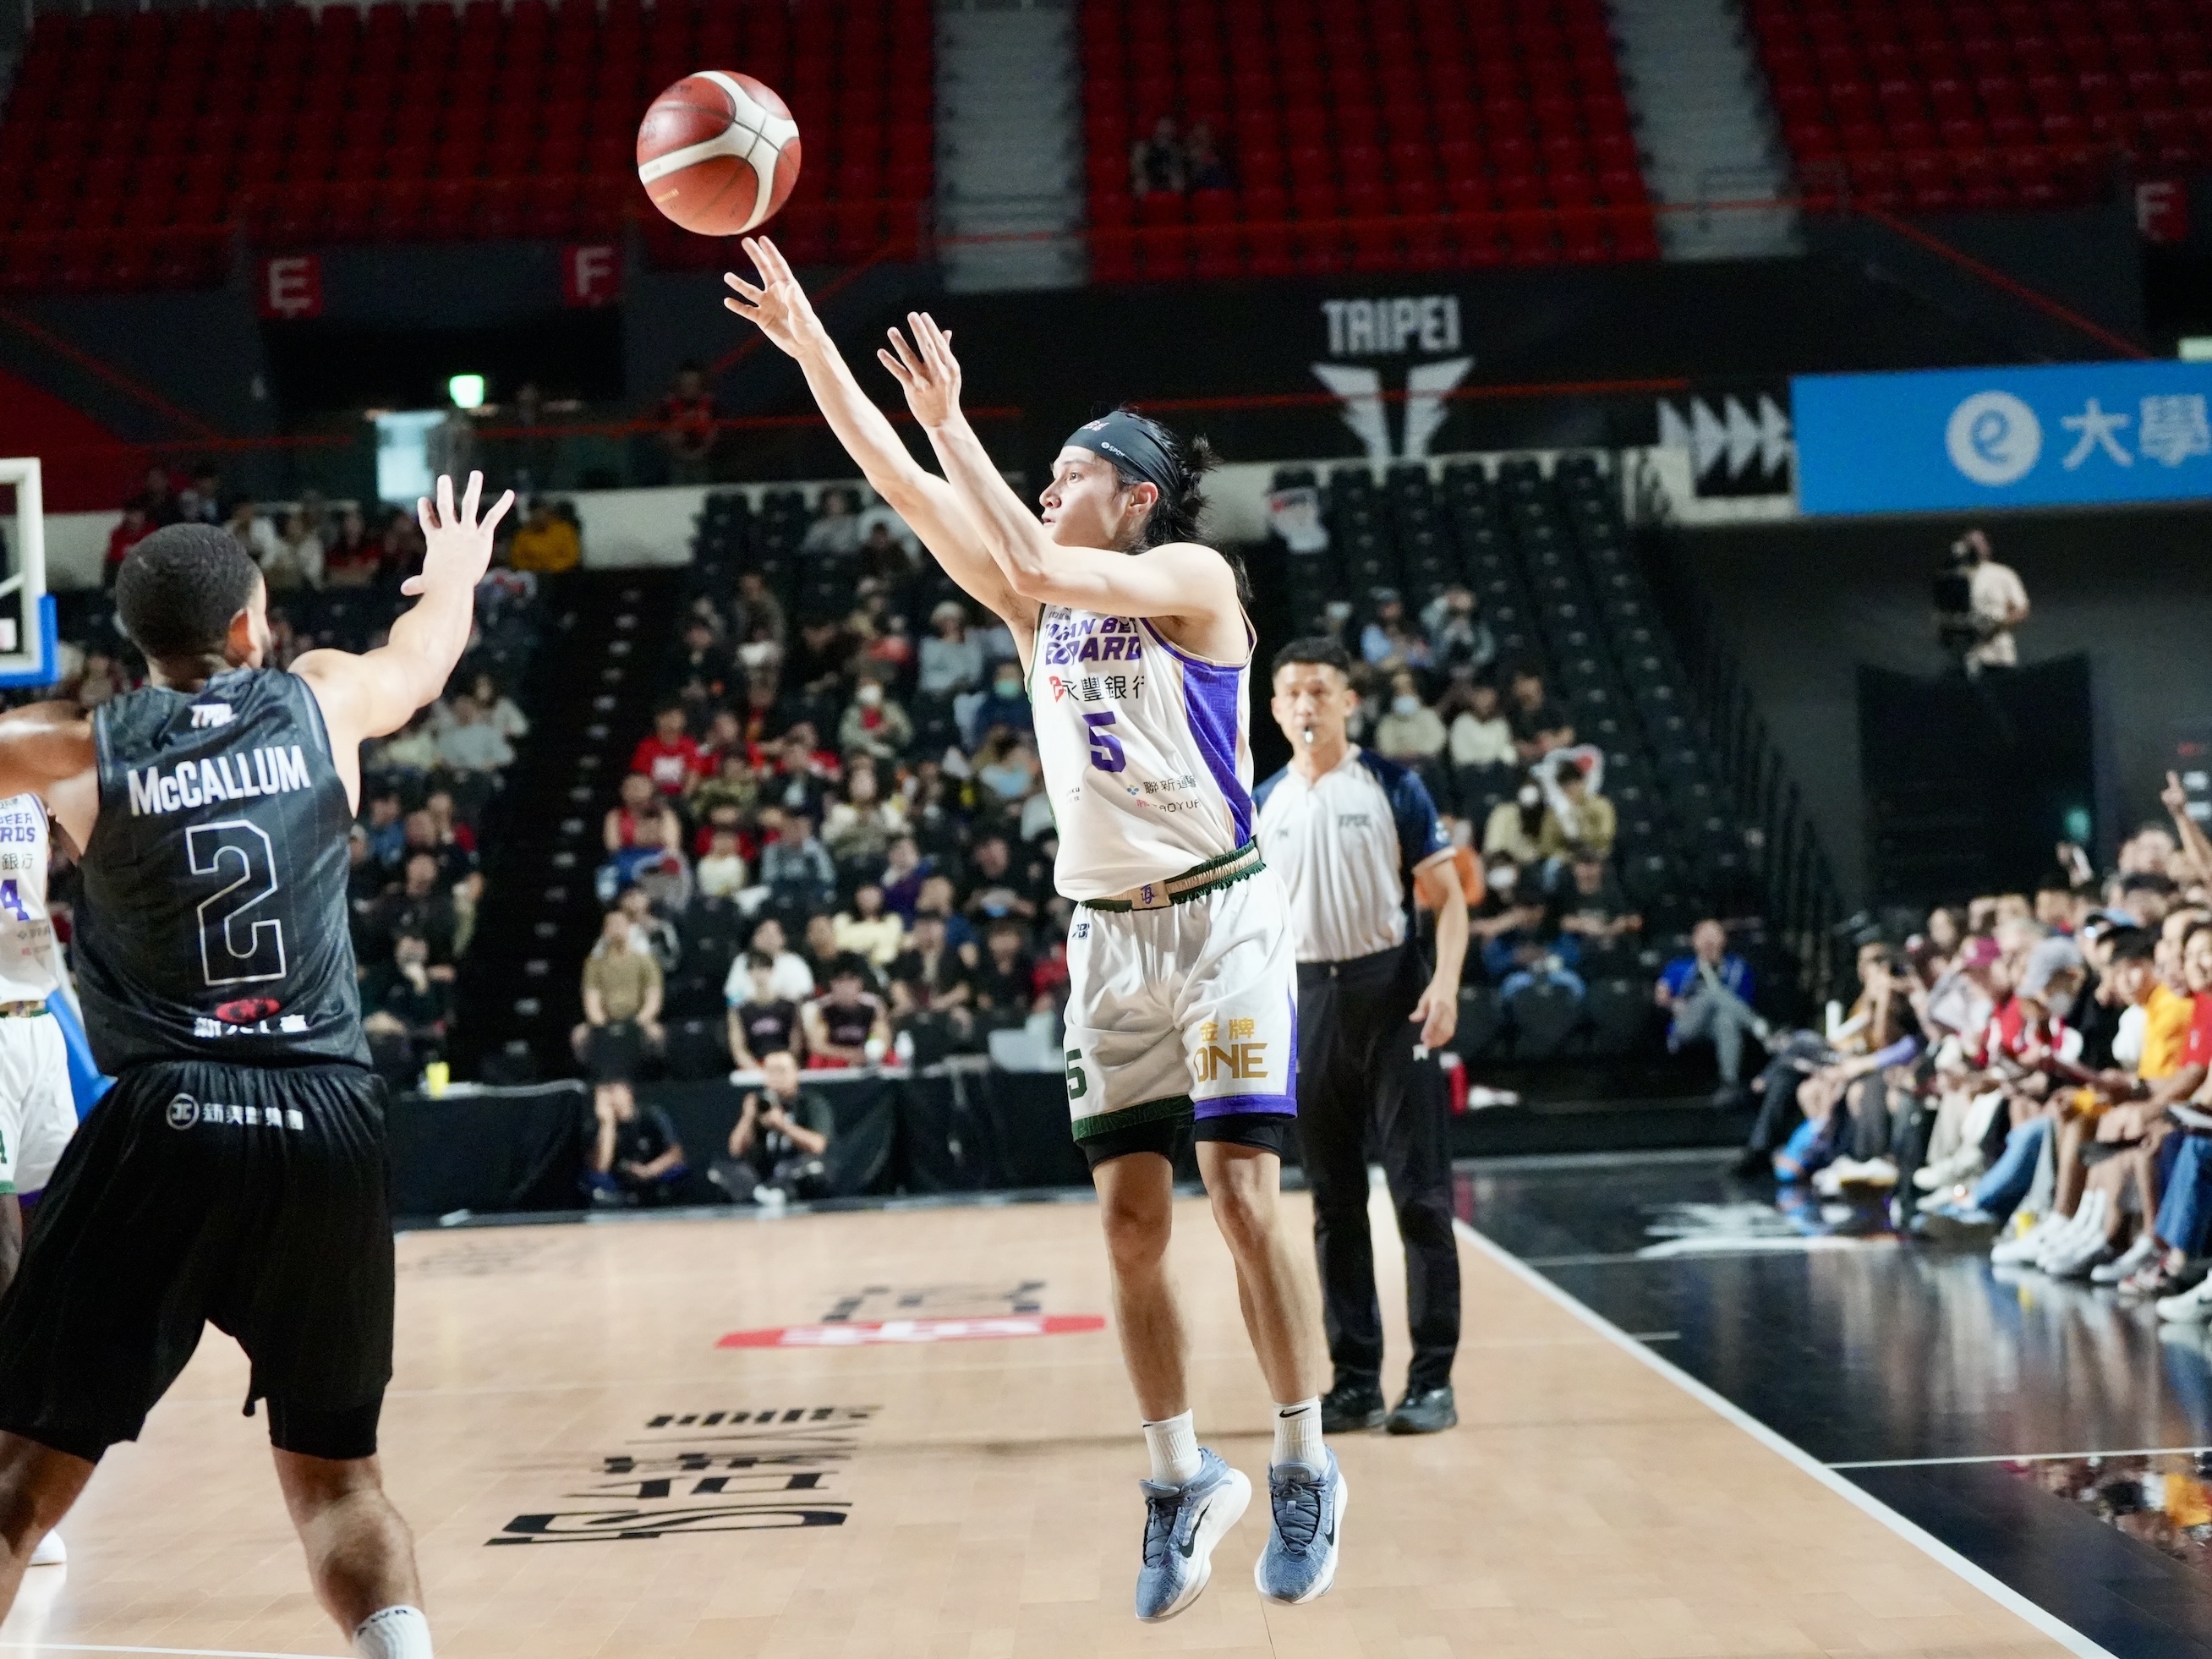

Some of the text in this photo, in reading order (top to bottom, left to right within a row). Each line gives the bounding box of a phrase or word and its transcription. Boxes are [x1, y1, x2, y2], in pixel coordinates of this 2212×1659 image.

[2135, 183, 2175, 230] F
[268, 258, 313, 309] E
[575, 247, 613, 296] F
[1322, 297, 1460, 353] TAIPEI
[1082, 711, 1126, 773] 5
[128, 745, 311, 817] McCALLUM
[185, 819, 287, 986] 2
[1200, 1018, 1255, 1043] 金牌
[1065, 1048, 1087, 1100] 5
[1193, 1043, 1269, 1082] ONE
